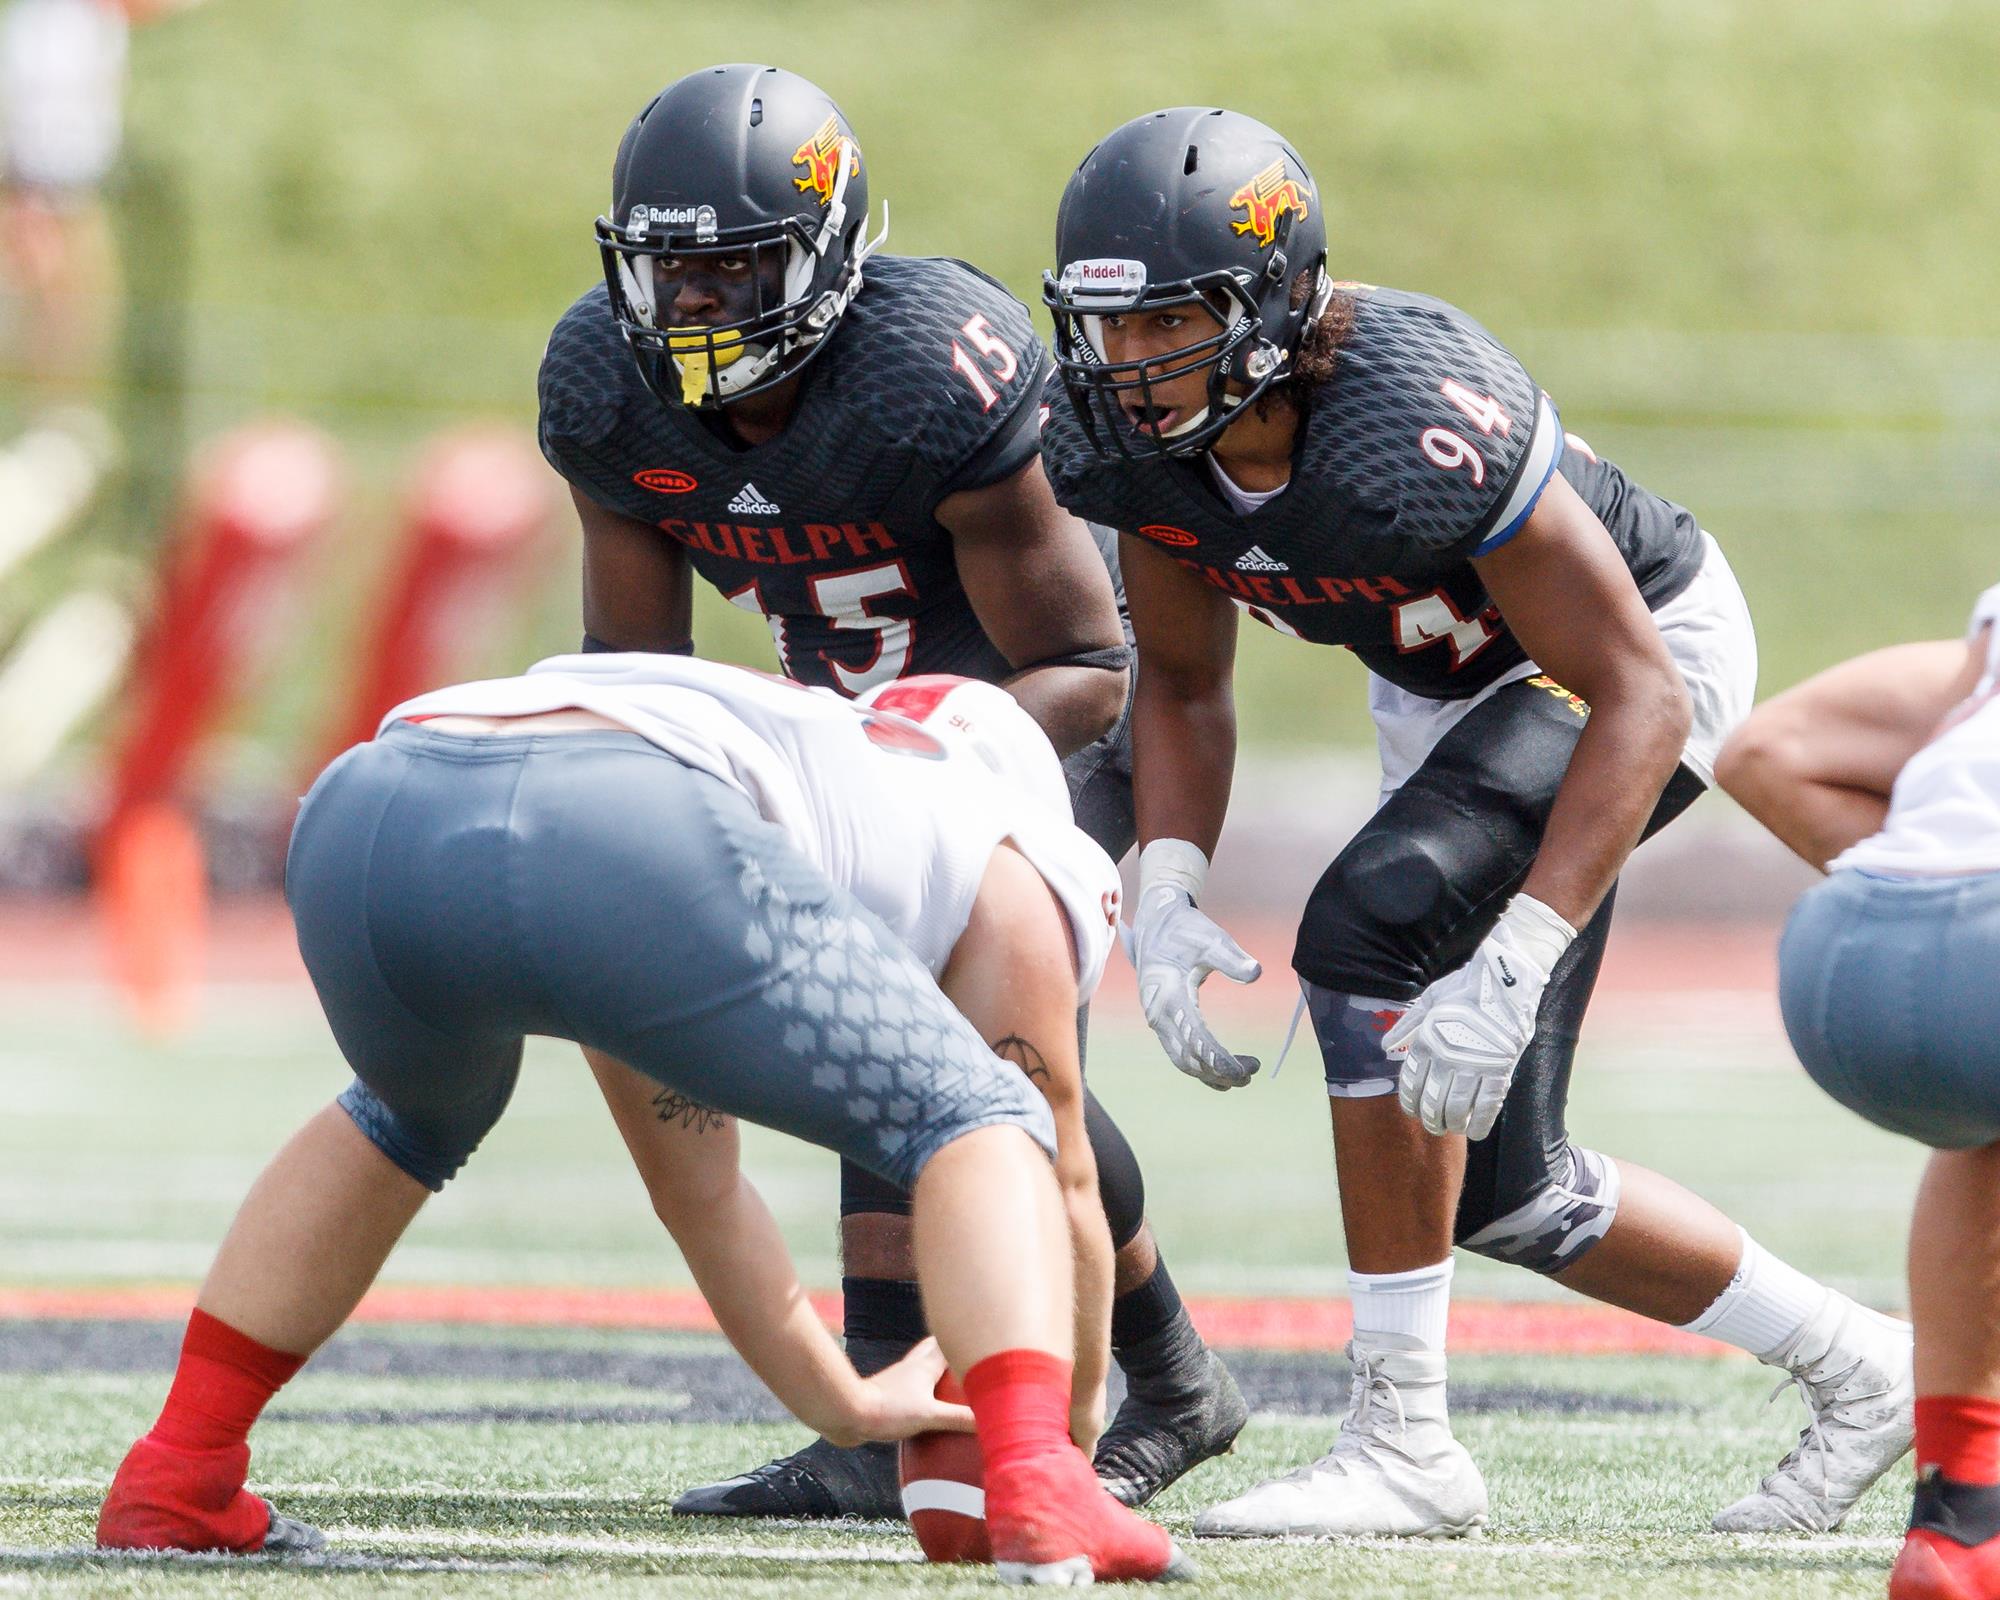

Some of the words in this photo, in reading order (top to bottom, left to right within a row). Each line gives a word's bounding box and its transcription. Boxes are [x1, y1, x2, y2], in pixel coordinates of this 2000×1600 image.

[649, 207, 696, 223] Riddell
[1083, 263, 1125, 279] Riddell
[951, 310, 1018, 415] 15
[1418, 375, 1516, 488] 94
[727, 502, 781, 515] adidas
[657, 518, 898, 566] GUELPH
[1235, 559, 1290, 572] adidas
